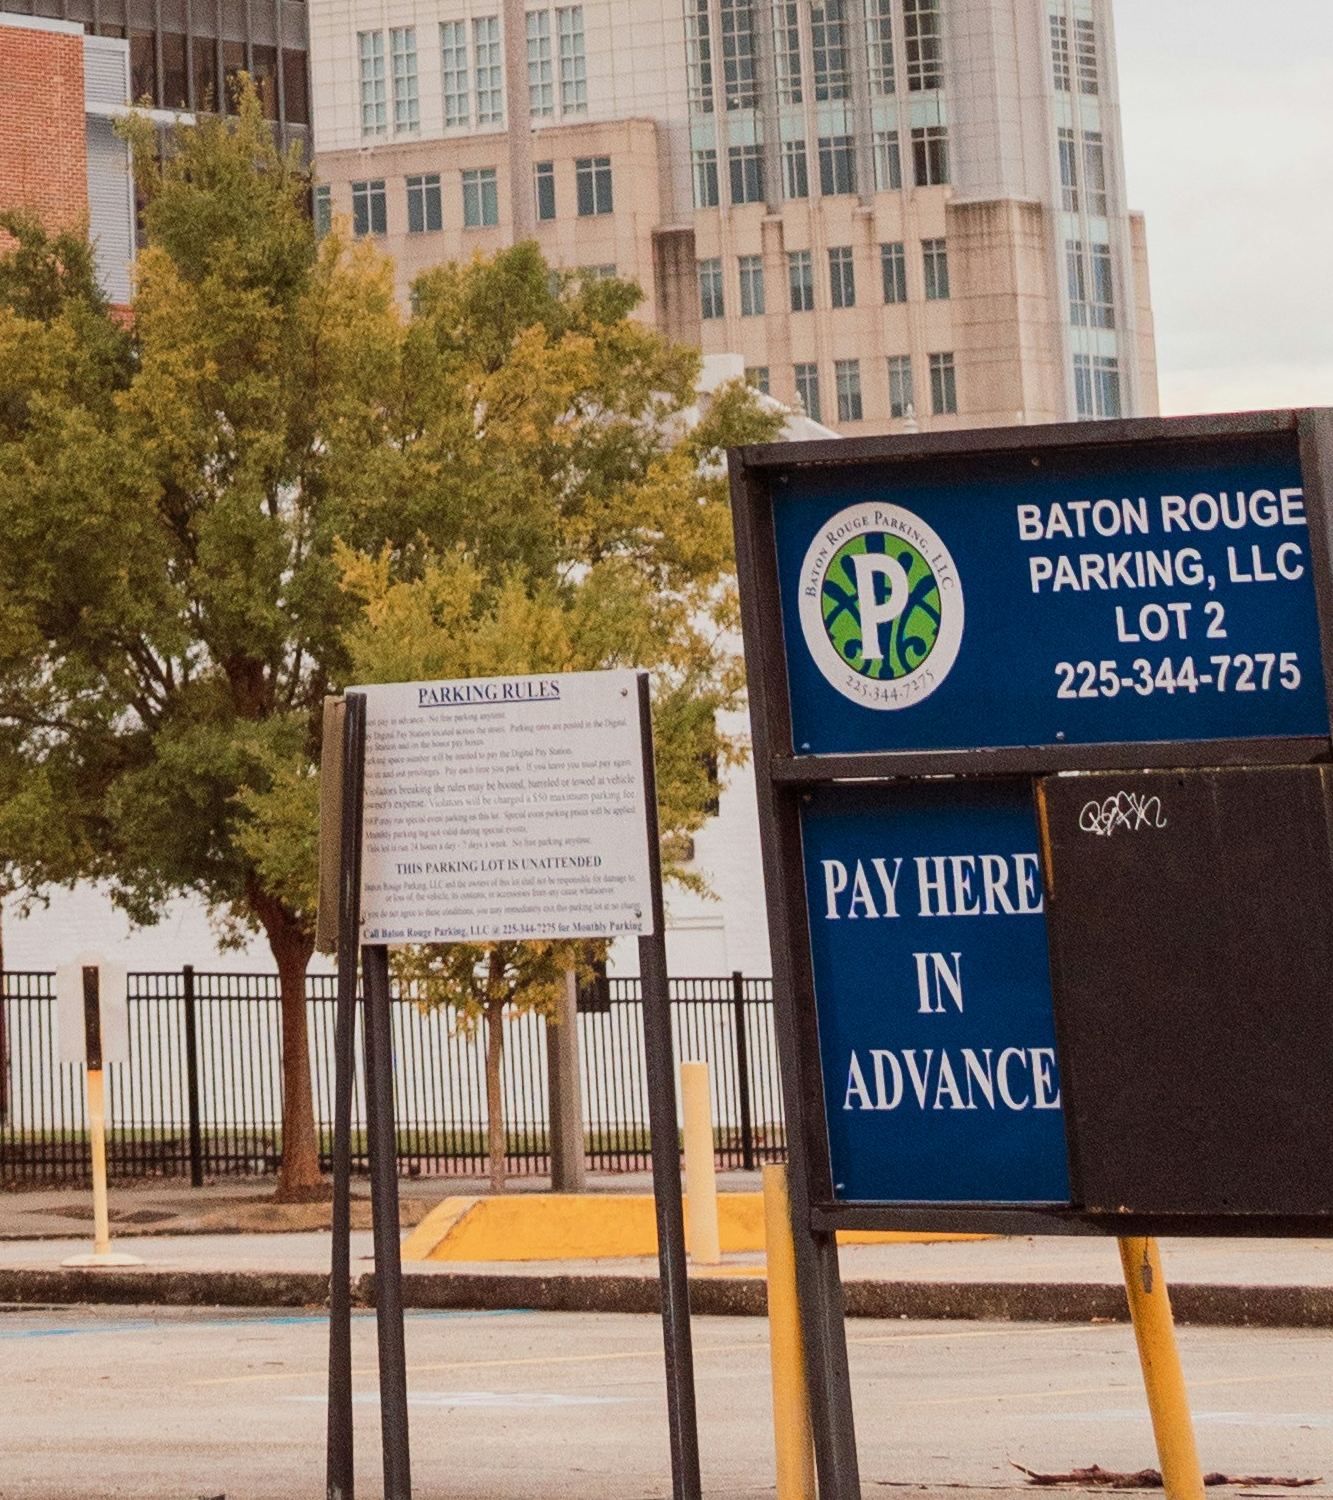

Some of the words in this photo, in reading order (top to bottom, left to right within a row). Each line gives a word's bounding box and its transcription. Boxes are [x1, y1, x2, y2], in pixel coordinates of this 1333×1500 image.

[1017, 497, 1149, 541] BATON
[1160, 487, 1308, 532] ROUGE
[805, 548, 828, 598] BATON
[826, 515, 869, 546] ROUGE
[873, 510, 930, 553] PARKING,
[931, 553, 955, 590] LLC
[1029, 547, 1216, 593] PARKING,
[1227, 542, 1304, 583] LLC
[849, 552, 909, 660] P
[1115, 602, 1192, 643] LOT
[1204, 601, 1227, 639] 2
[418, 684, 497, 704] PARKING
[502, 680, 559, 698] RULES
[1054, 652, 1302, 699] 225-344-7275
[395, 863, 422, 874] THIS
[425, 861, 477, 872] PARKING
[480, 860, 504, 870] LOT
[521, 855, 601, 868] UNATTENDED
[820, 858, 903, 920] PAY
[913, 853, 1044, 917] HERE
[406, 927, 431, 939] Rouge
[434, 925, 468, 938] Parking,
[470, 925, 489, 934] LLC
[609, 919, 642, 932] Parking
[912, 952, 964, 1013] IN
[842, 1047, 1061, 1111] ADVANCE
